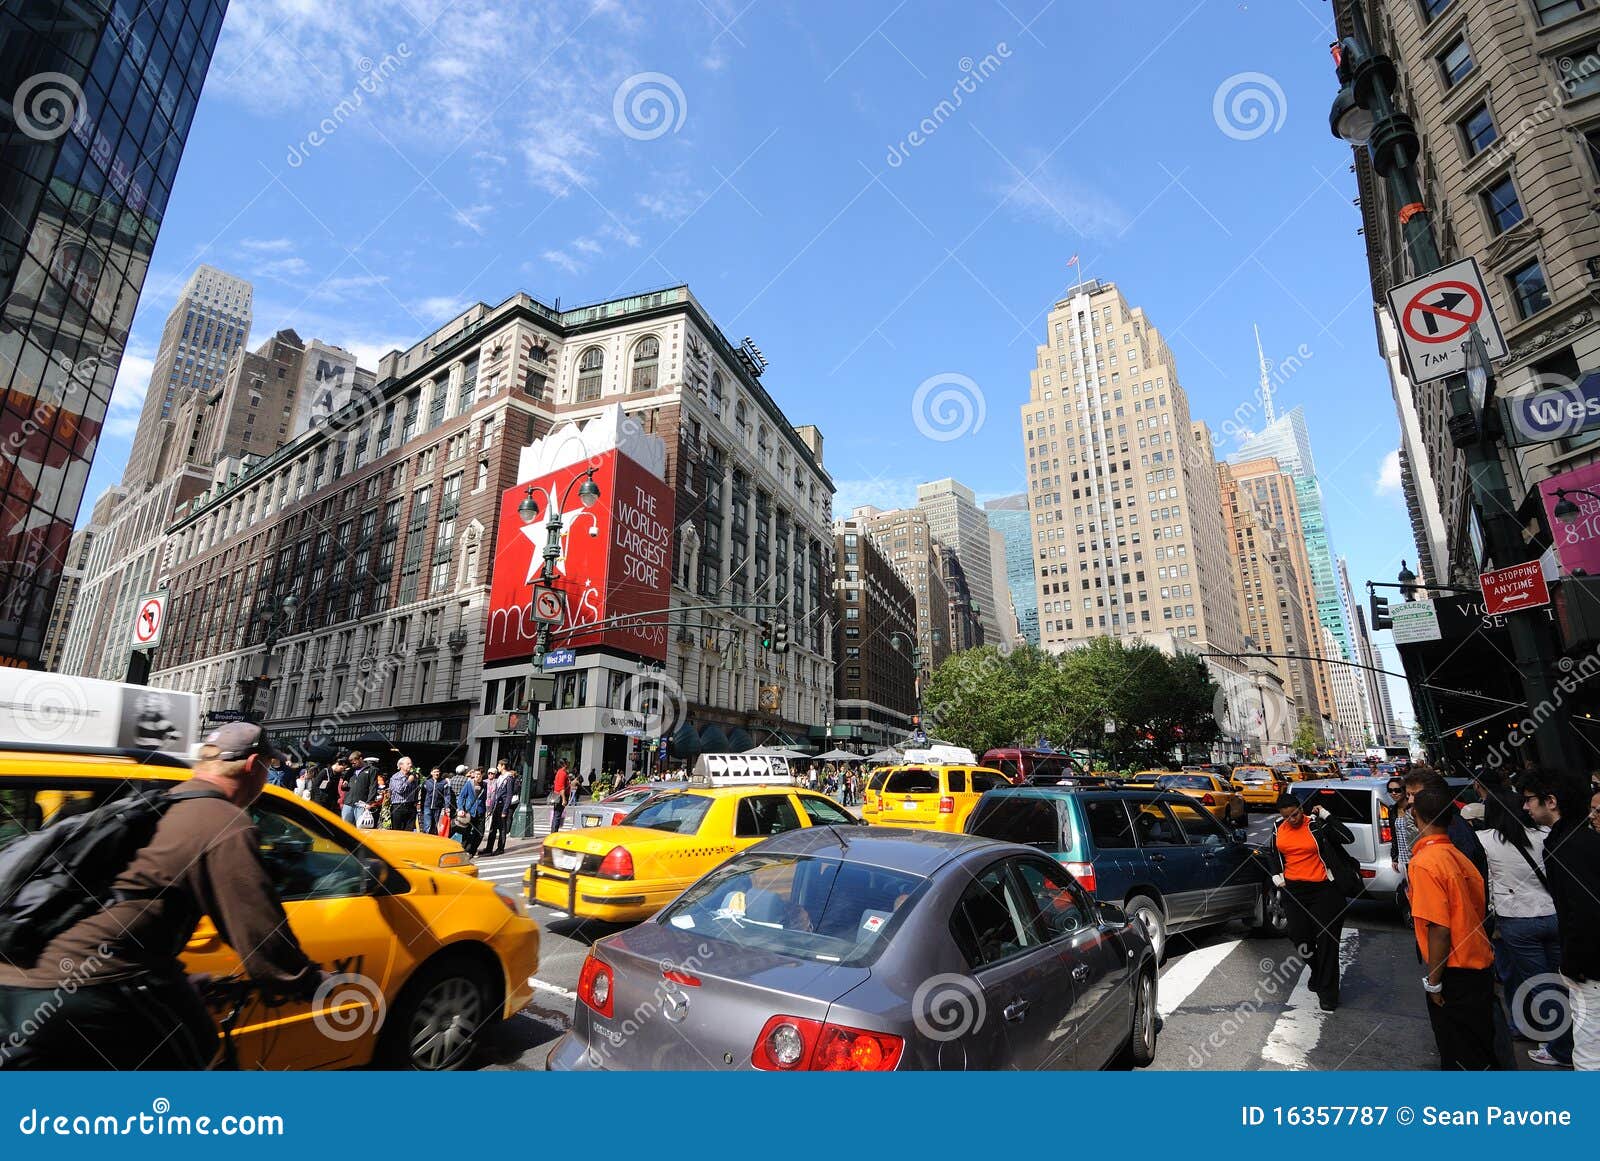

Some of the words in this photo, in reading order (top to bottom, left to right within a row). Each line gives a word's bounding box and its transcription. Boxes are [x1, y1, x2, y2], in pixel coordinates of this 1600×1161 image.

[1420, 352, 1448, 367] 7AM
[635, 486, 656, 517] THE
[618, 499, 669, 547] WORLD'S
[616, 524, 667, 568] LARGEST
[623, 554, 659, 589] STORE
[1484, 576, 1494, 585] NO
[1498, 565, 1538, 582] STOPPING
[1494, 579, 1535, 595] ANYTIME
[215, 713, 246, 721] Broadway
